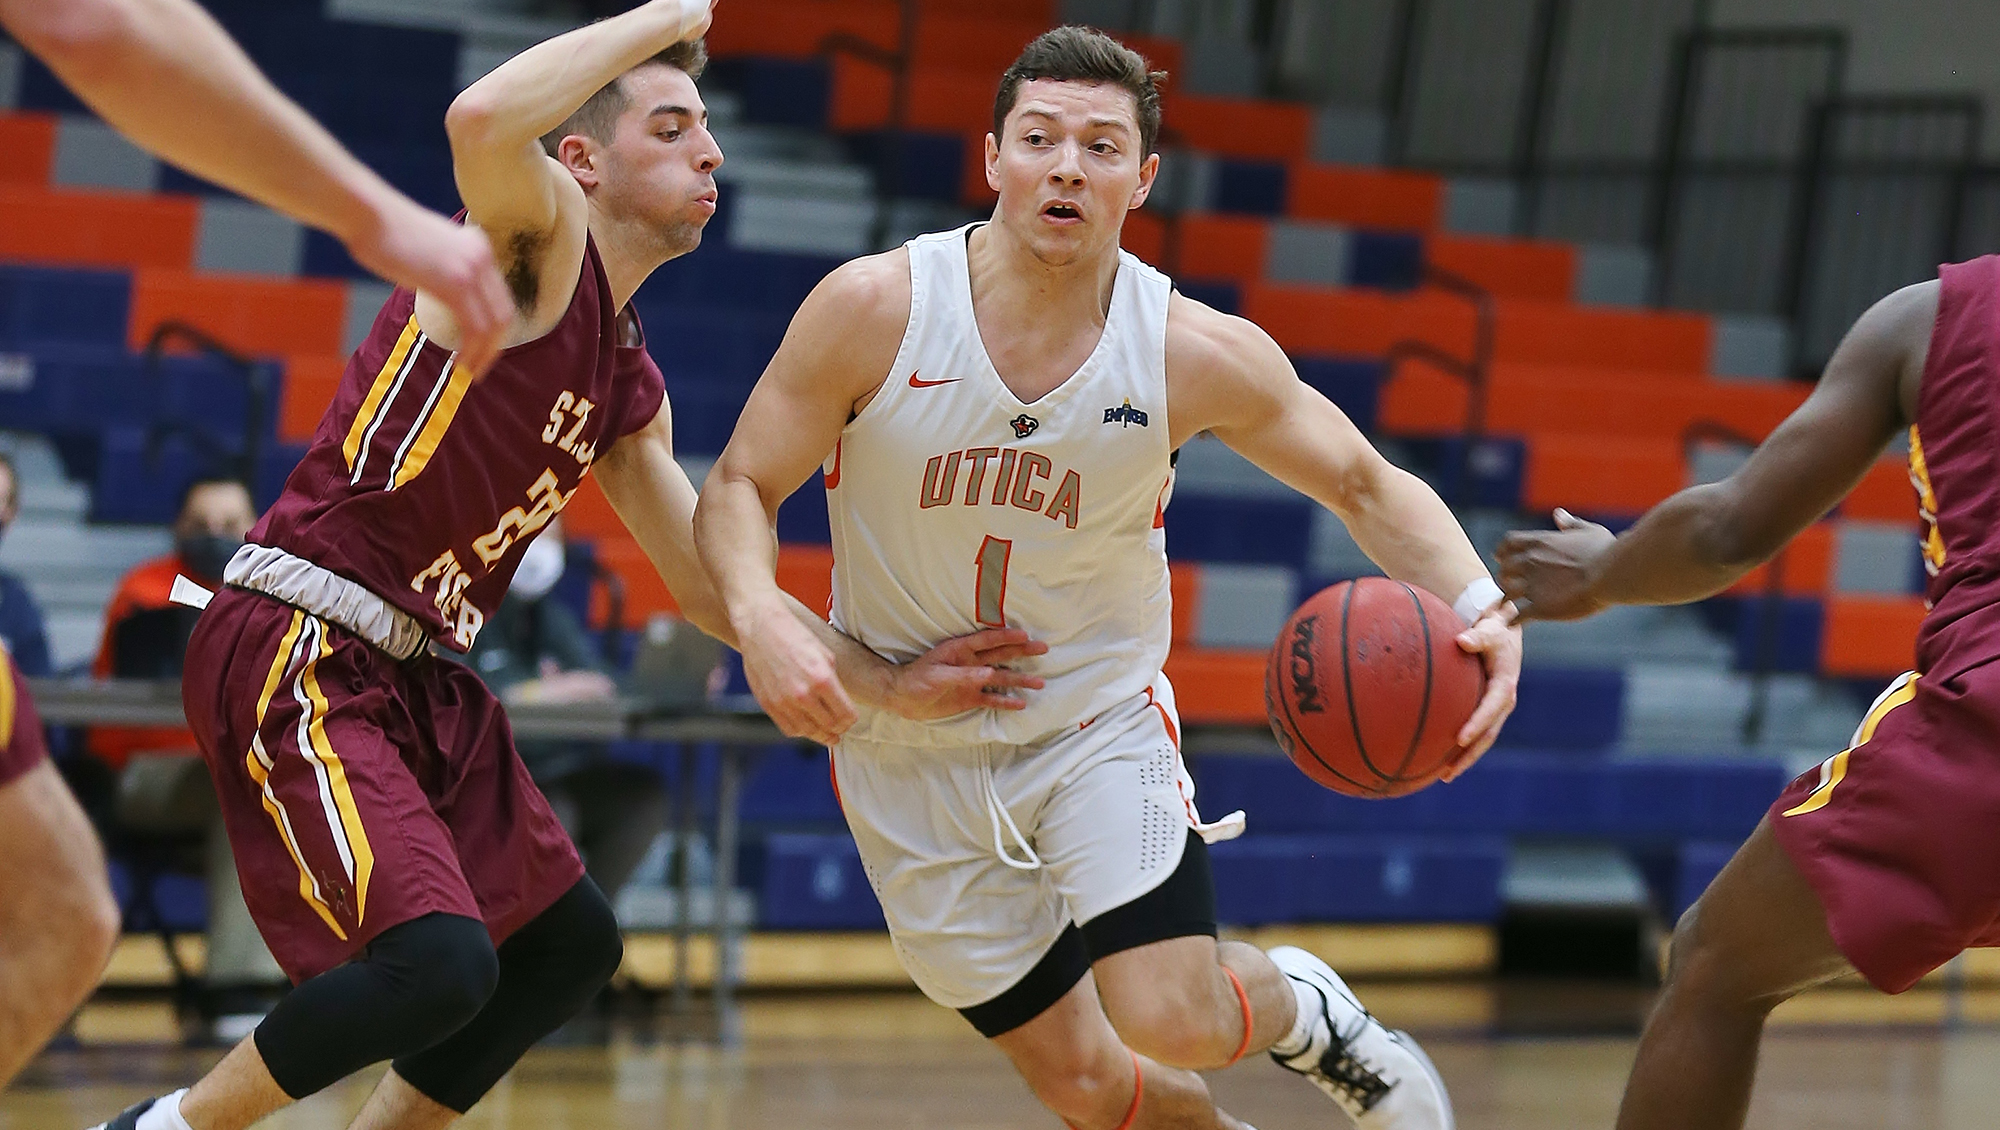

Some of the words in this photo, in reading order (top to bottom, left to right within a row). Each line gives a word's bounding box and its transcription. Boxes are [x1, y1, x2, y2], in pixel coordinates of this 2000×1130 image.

[919, 447, 1081, 529] UTICA
[974, 534, 1013, 628] 1
[1291, 614, 1326, 716] NCAA
